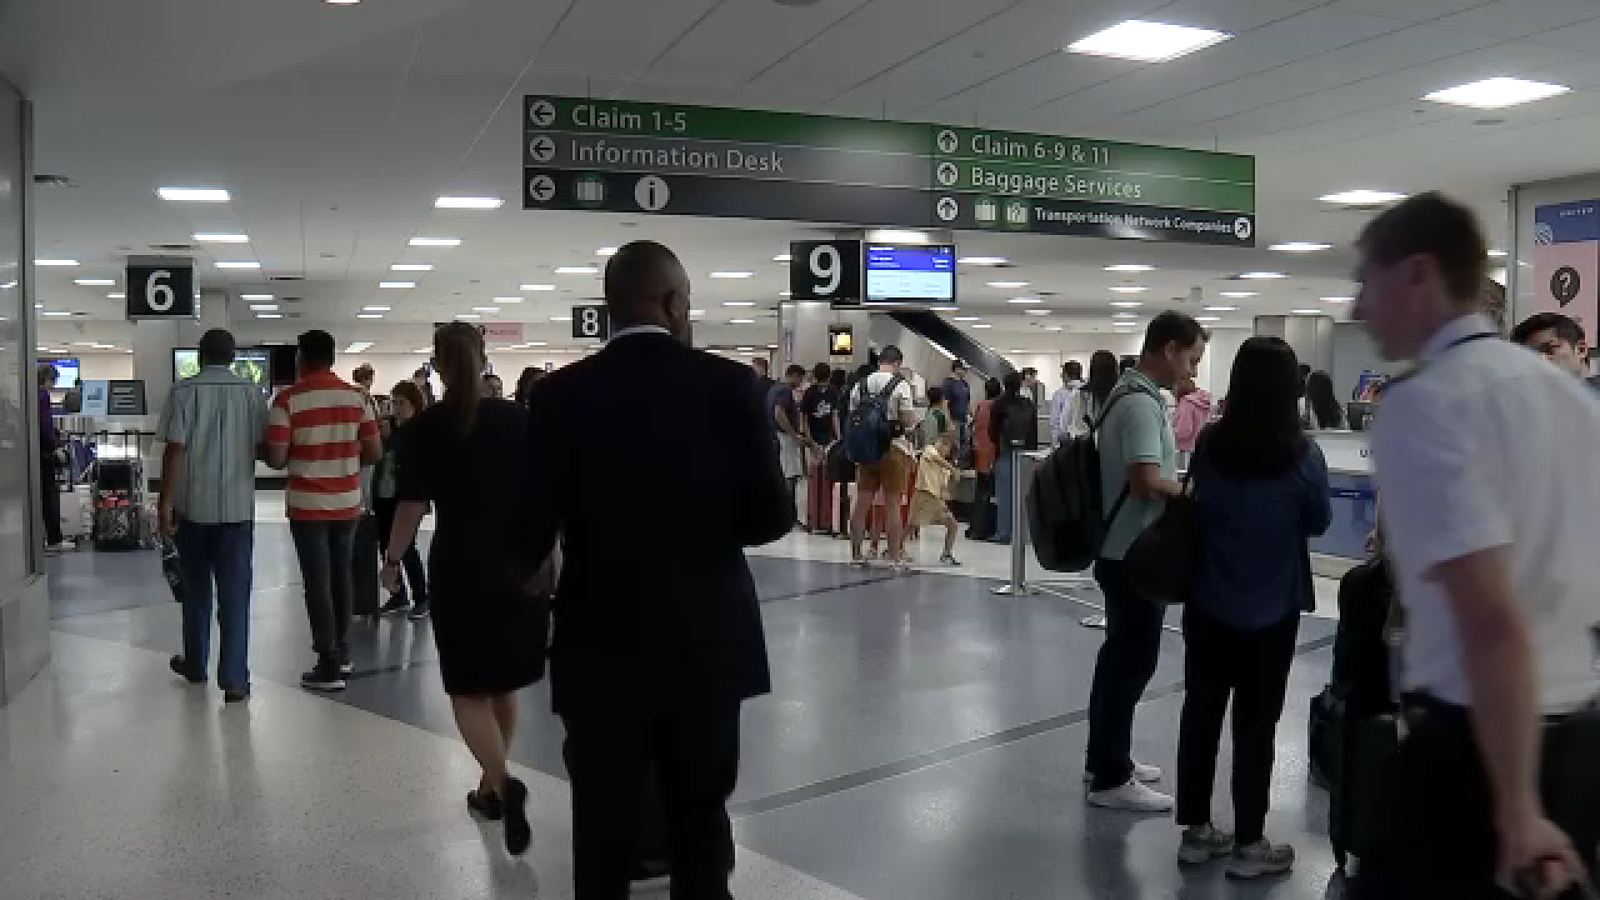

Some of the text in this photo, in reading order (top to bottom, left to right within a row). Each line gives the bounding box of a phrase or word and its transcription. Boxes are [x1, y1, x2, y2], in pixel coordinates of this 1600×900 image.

[572, 104, 687, 132] Claim 1-5
[571, 139, 784, 173] Information Desk
[971, 134, 1110, 165] Claim 6-9 & 11
[971, 167, 1141, 199] Baggage Services
[1034, 206, 1123, 226] Transportation
[1174, 218, 1231, 234] Companies
[809, 244, 841, 296] 9
[146, 269, 175, 311] 6
[582, 308, 599, 336] 8
